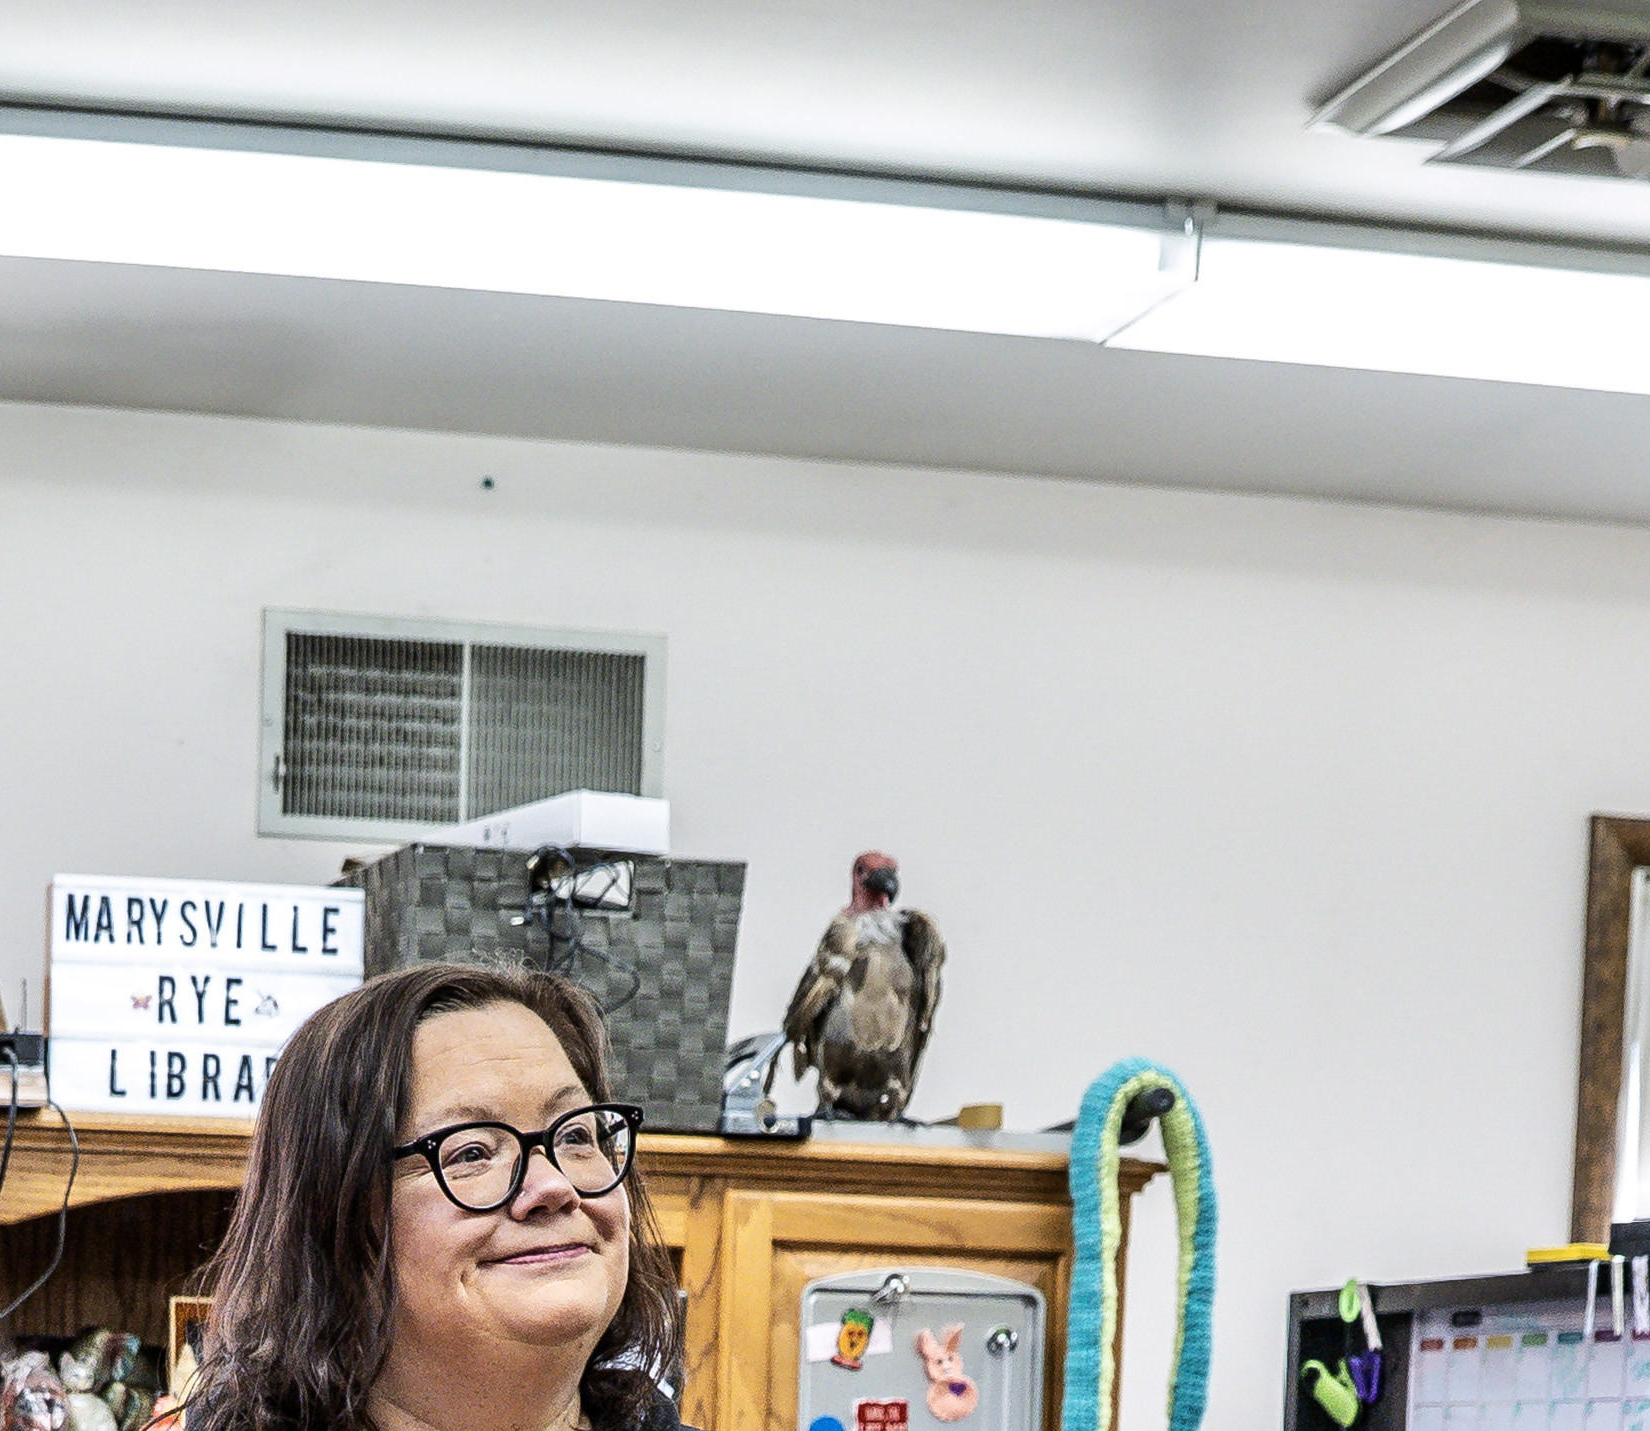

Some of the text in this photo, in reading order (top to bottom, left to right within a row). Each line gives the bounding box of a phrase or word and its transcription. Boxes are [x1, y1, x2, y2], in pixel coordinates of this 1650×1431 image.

[63, 891, 341, 956] MARYSVILLE
[156, 975, 245, 1027] RYE
[108, 1048, 278, 1105] LIBRA
